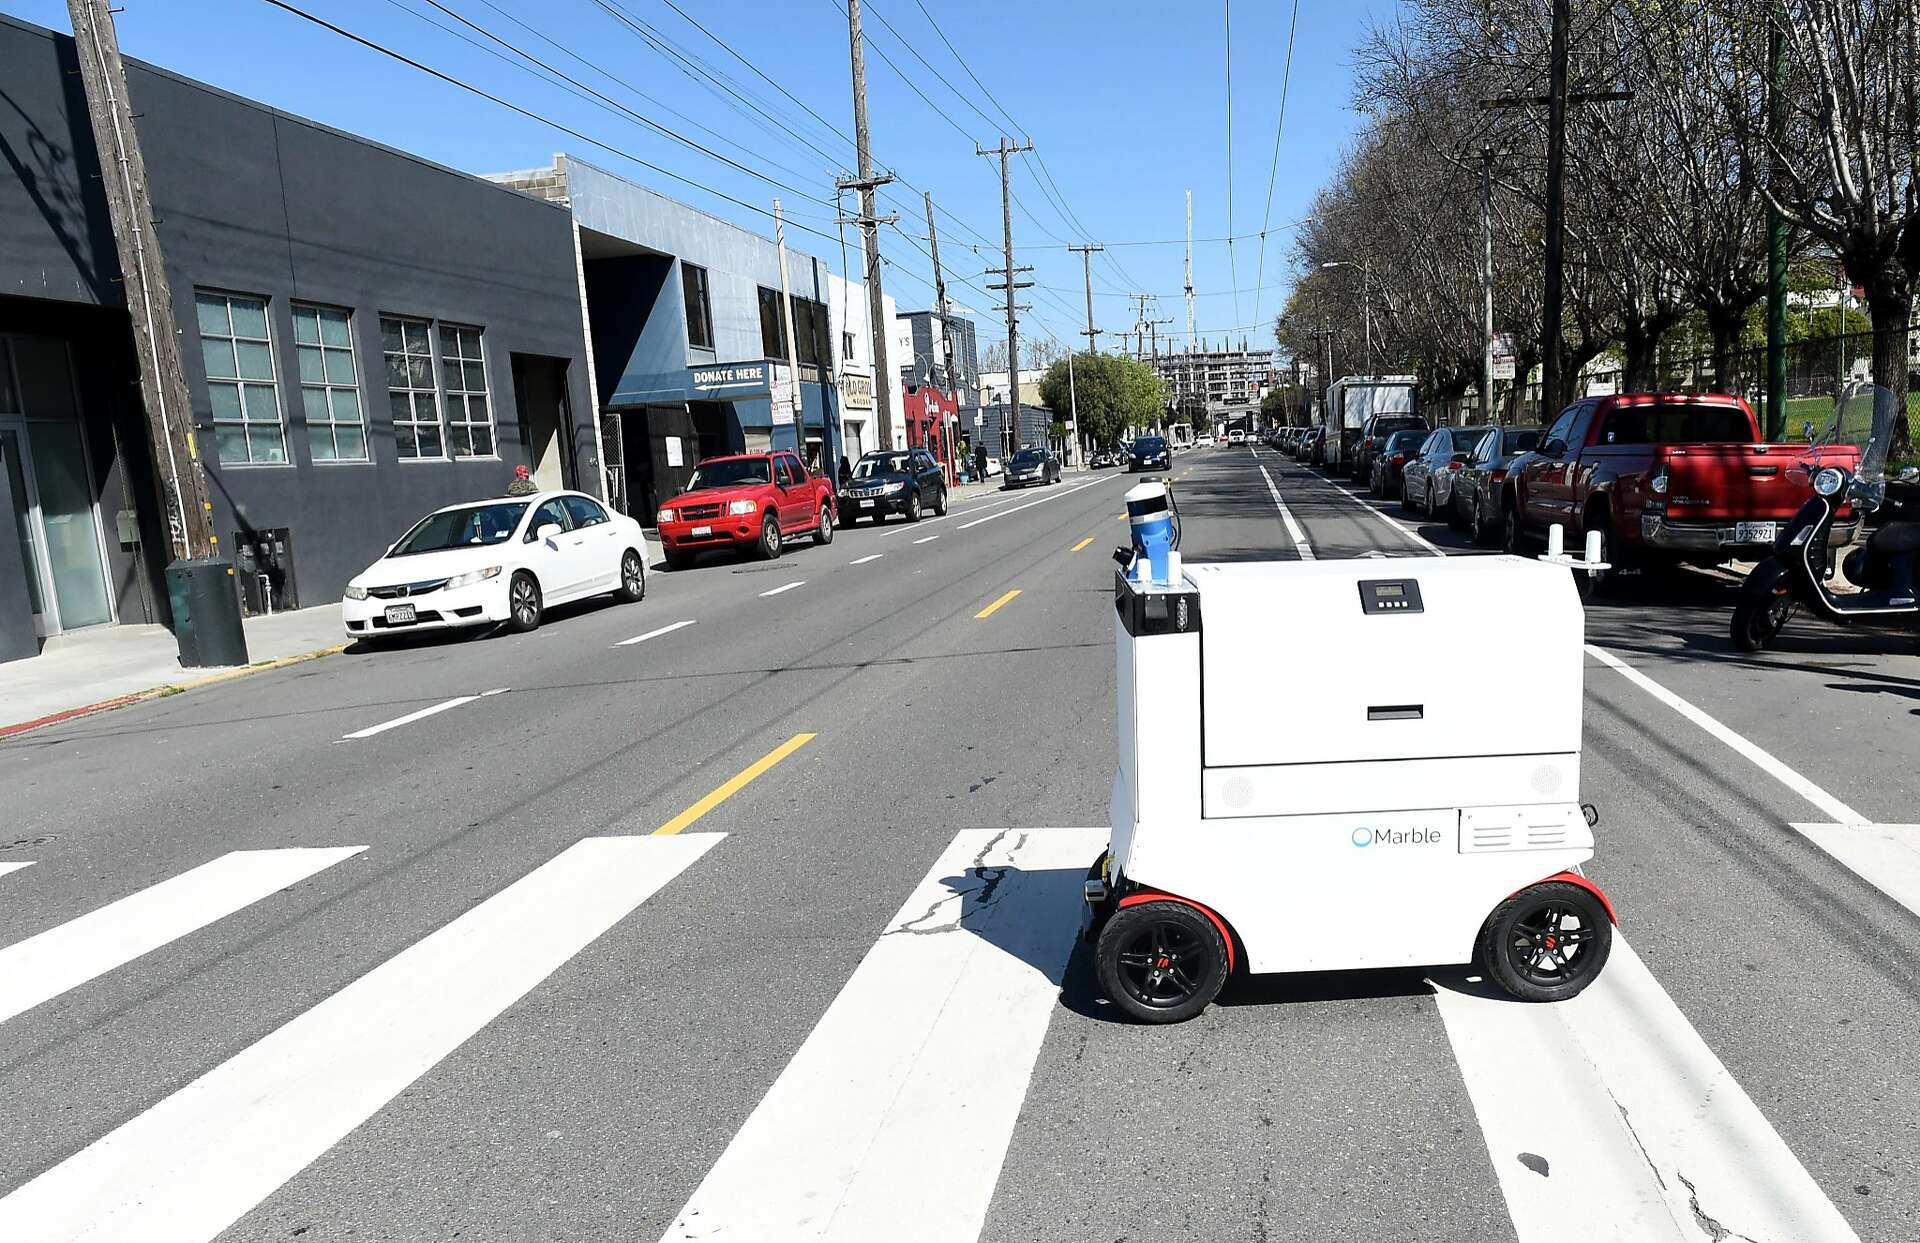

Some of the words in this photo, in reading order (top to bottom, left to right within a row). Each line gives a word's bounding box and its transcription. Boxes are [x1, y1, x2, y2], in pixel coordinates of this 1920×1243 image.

[694, 371, 733, 383] DONATE
[736, 368, 763, 380] HERE
[1375, 827, 1441, 845] Marble
